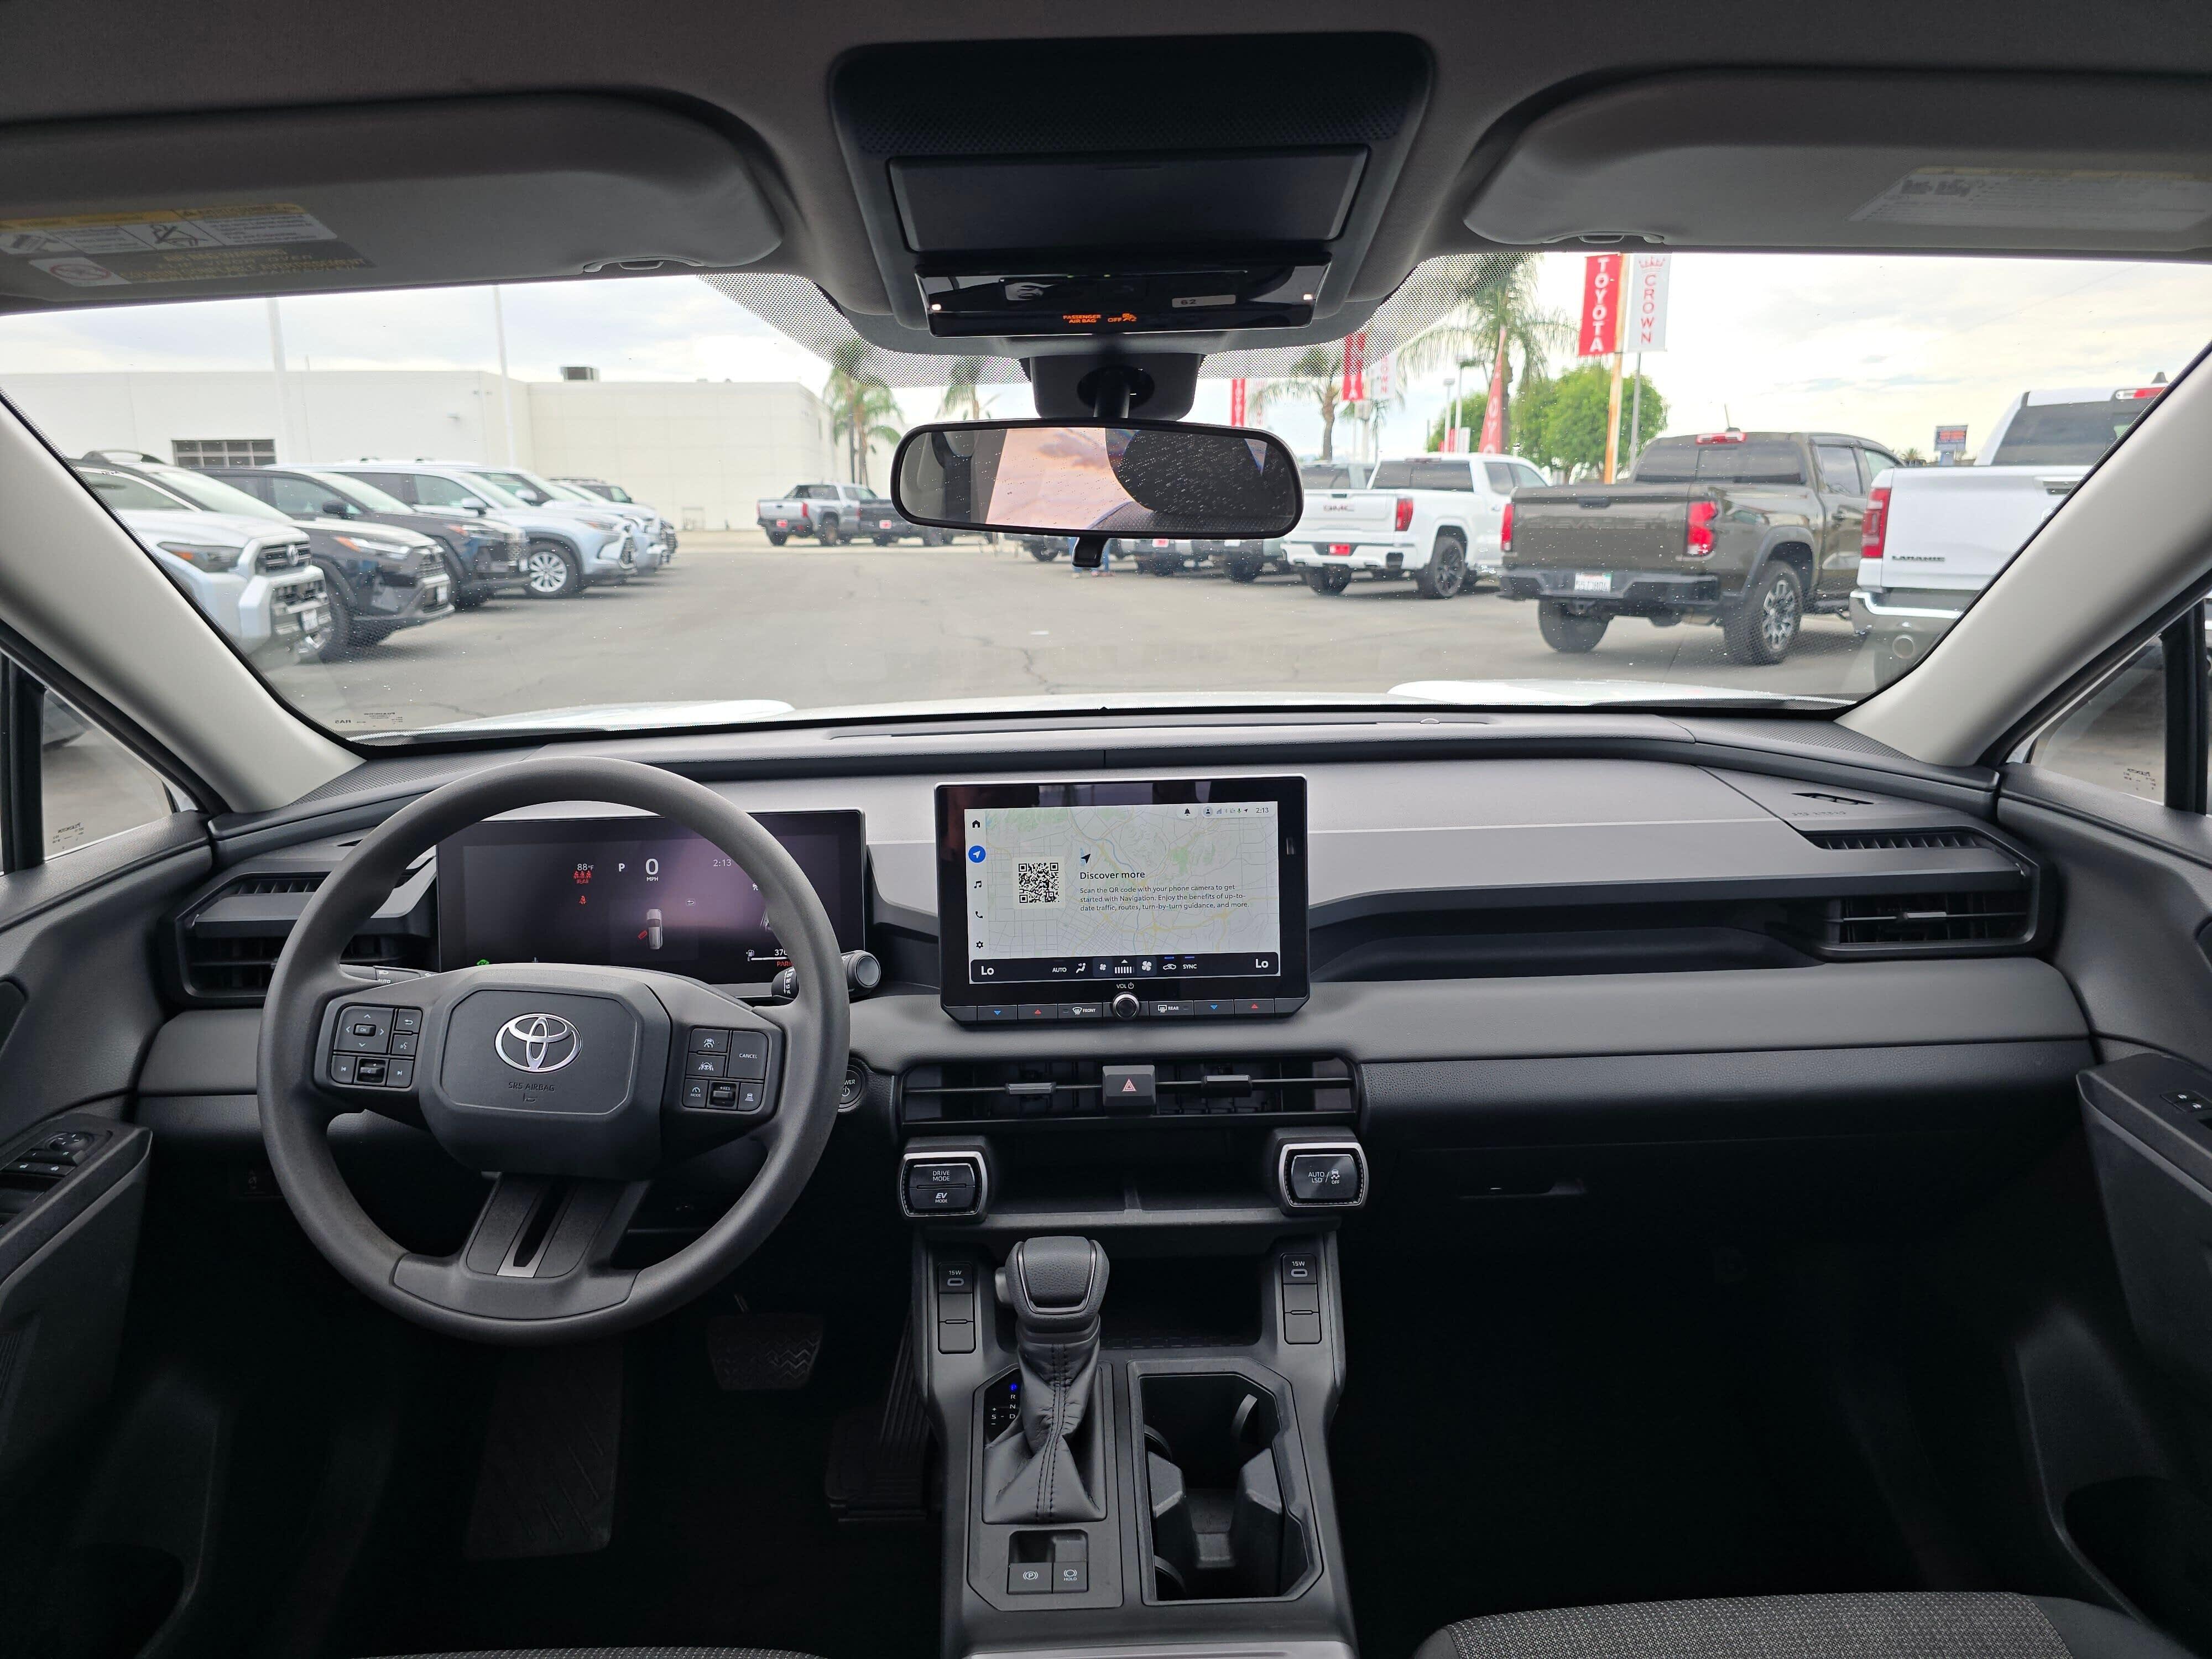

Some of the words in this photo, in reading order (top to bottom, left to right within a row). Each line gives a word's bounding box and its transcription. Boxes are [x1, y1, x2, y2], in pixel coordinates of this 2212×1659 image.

[1589, 257, 1610, 352] TOYOTA
[1641, 274, 1656, 344] CROWN
[618, 863, 625, 872] P
[645, 858, 659, 875] 0
[1255, 958, 1269, 968] Lo
[981, 966, 994, 975] Lo
